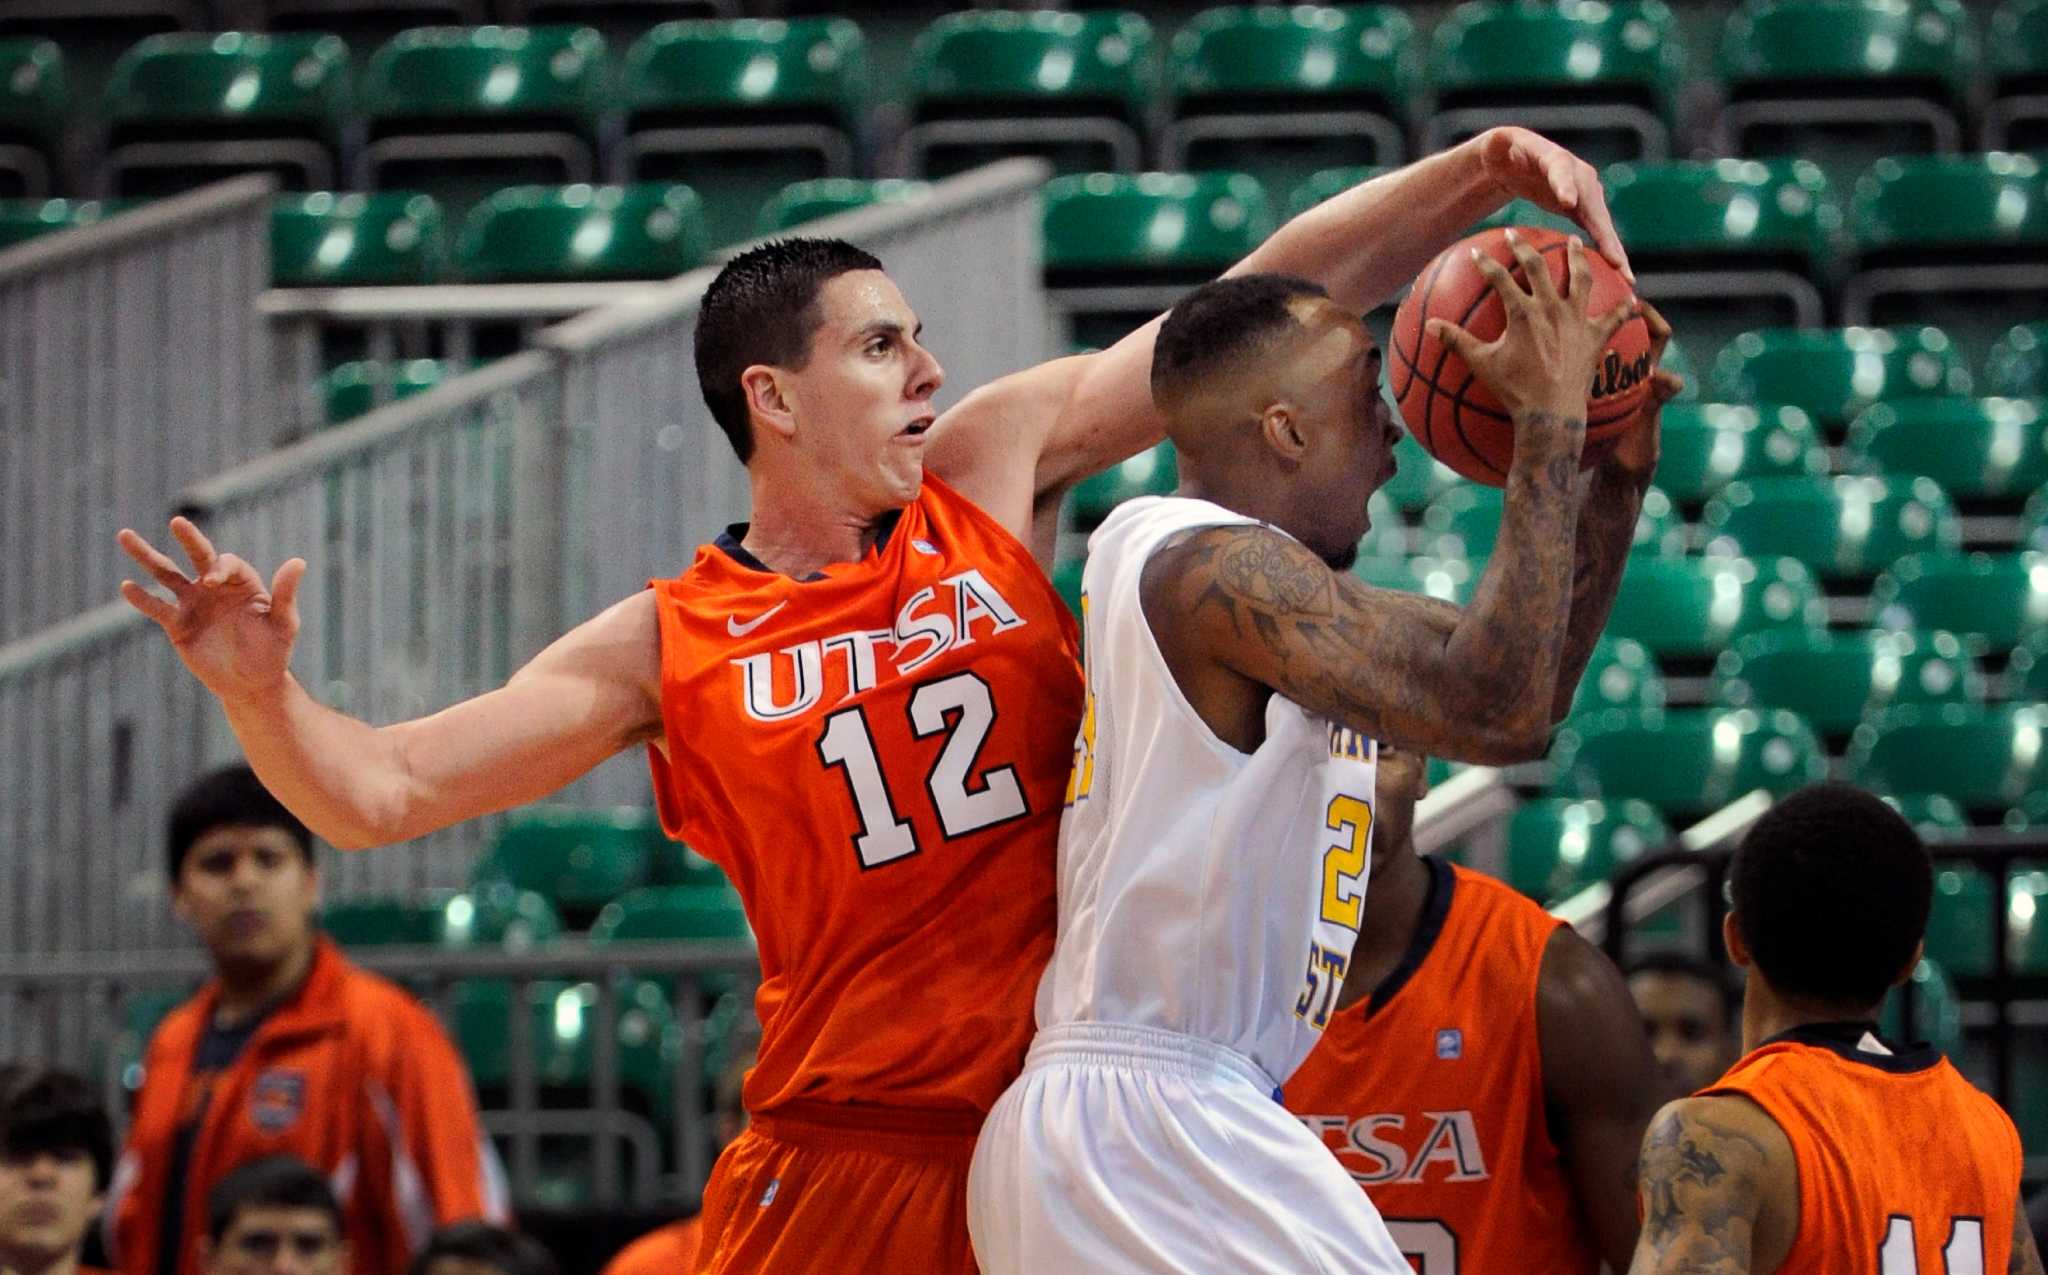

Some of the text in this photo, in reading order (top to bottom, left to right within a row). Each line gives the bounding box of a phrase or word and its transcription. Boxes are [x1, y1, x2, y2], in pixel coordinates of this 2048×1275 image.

[1590, 353, 1650, 398] ilson
[729, 568, 1027, 722] UTSA
[816, 670, 1030, 871] 12
[1321, 793, 1372, 932] 2
[1296, 1110, 1491, 1185] TSA
